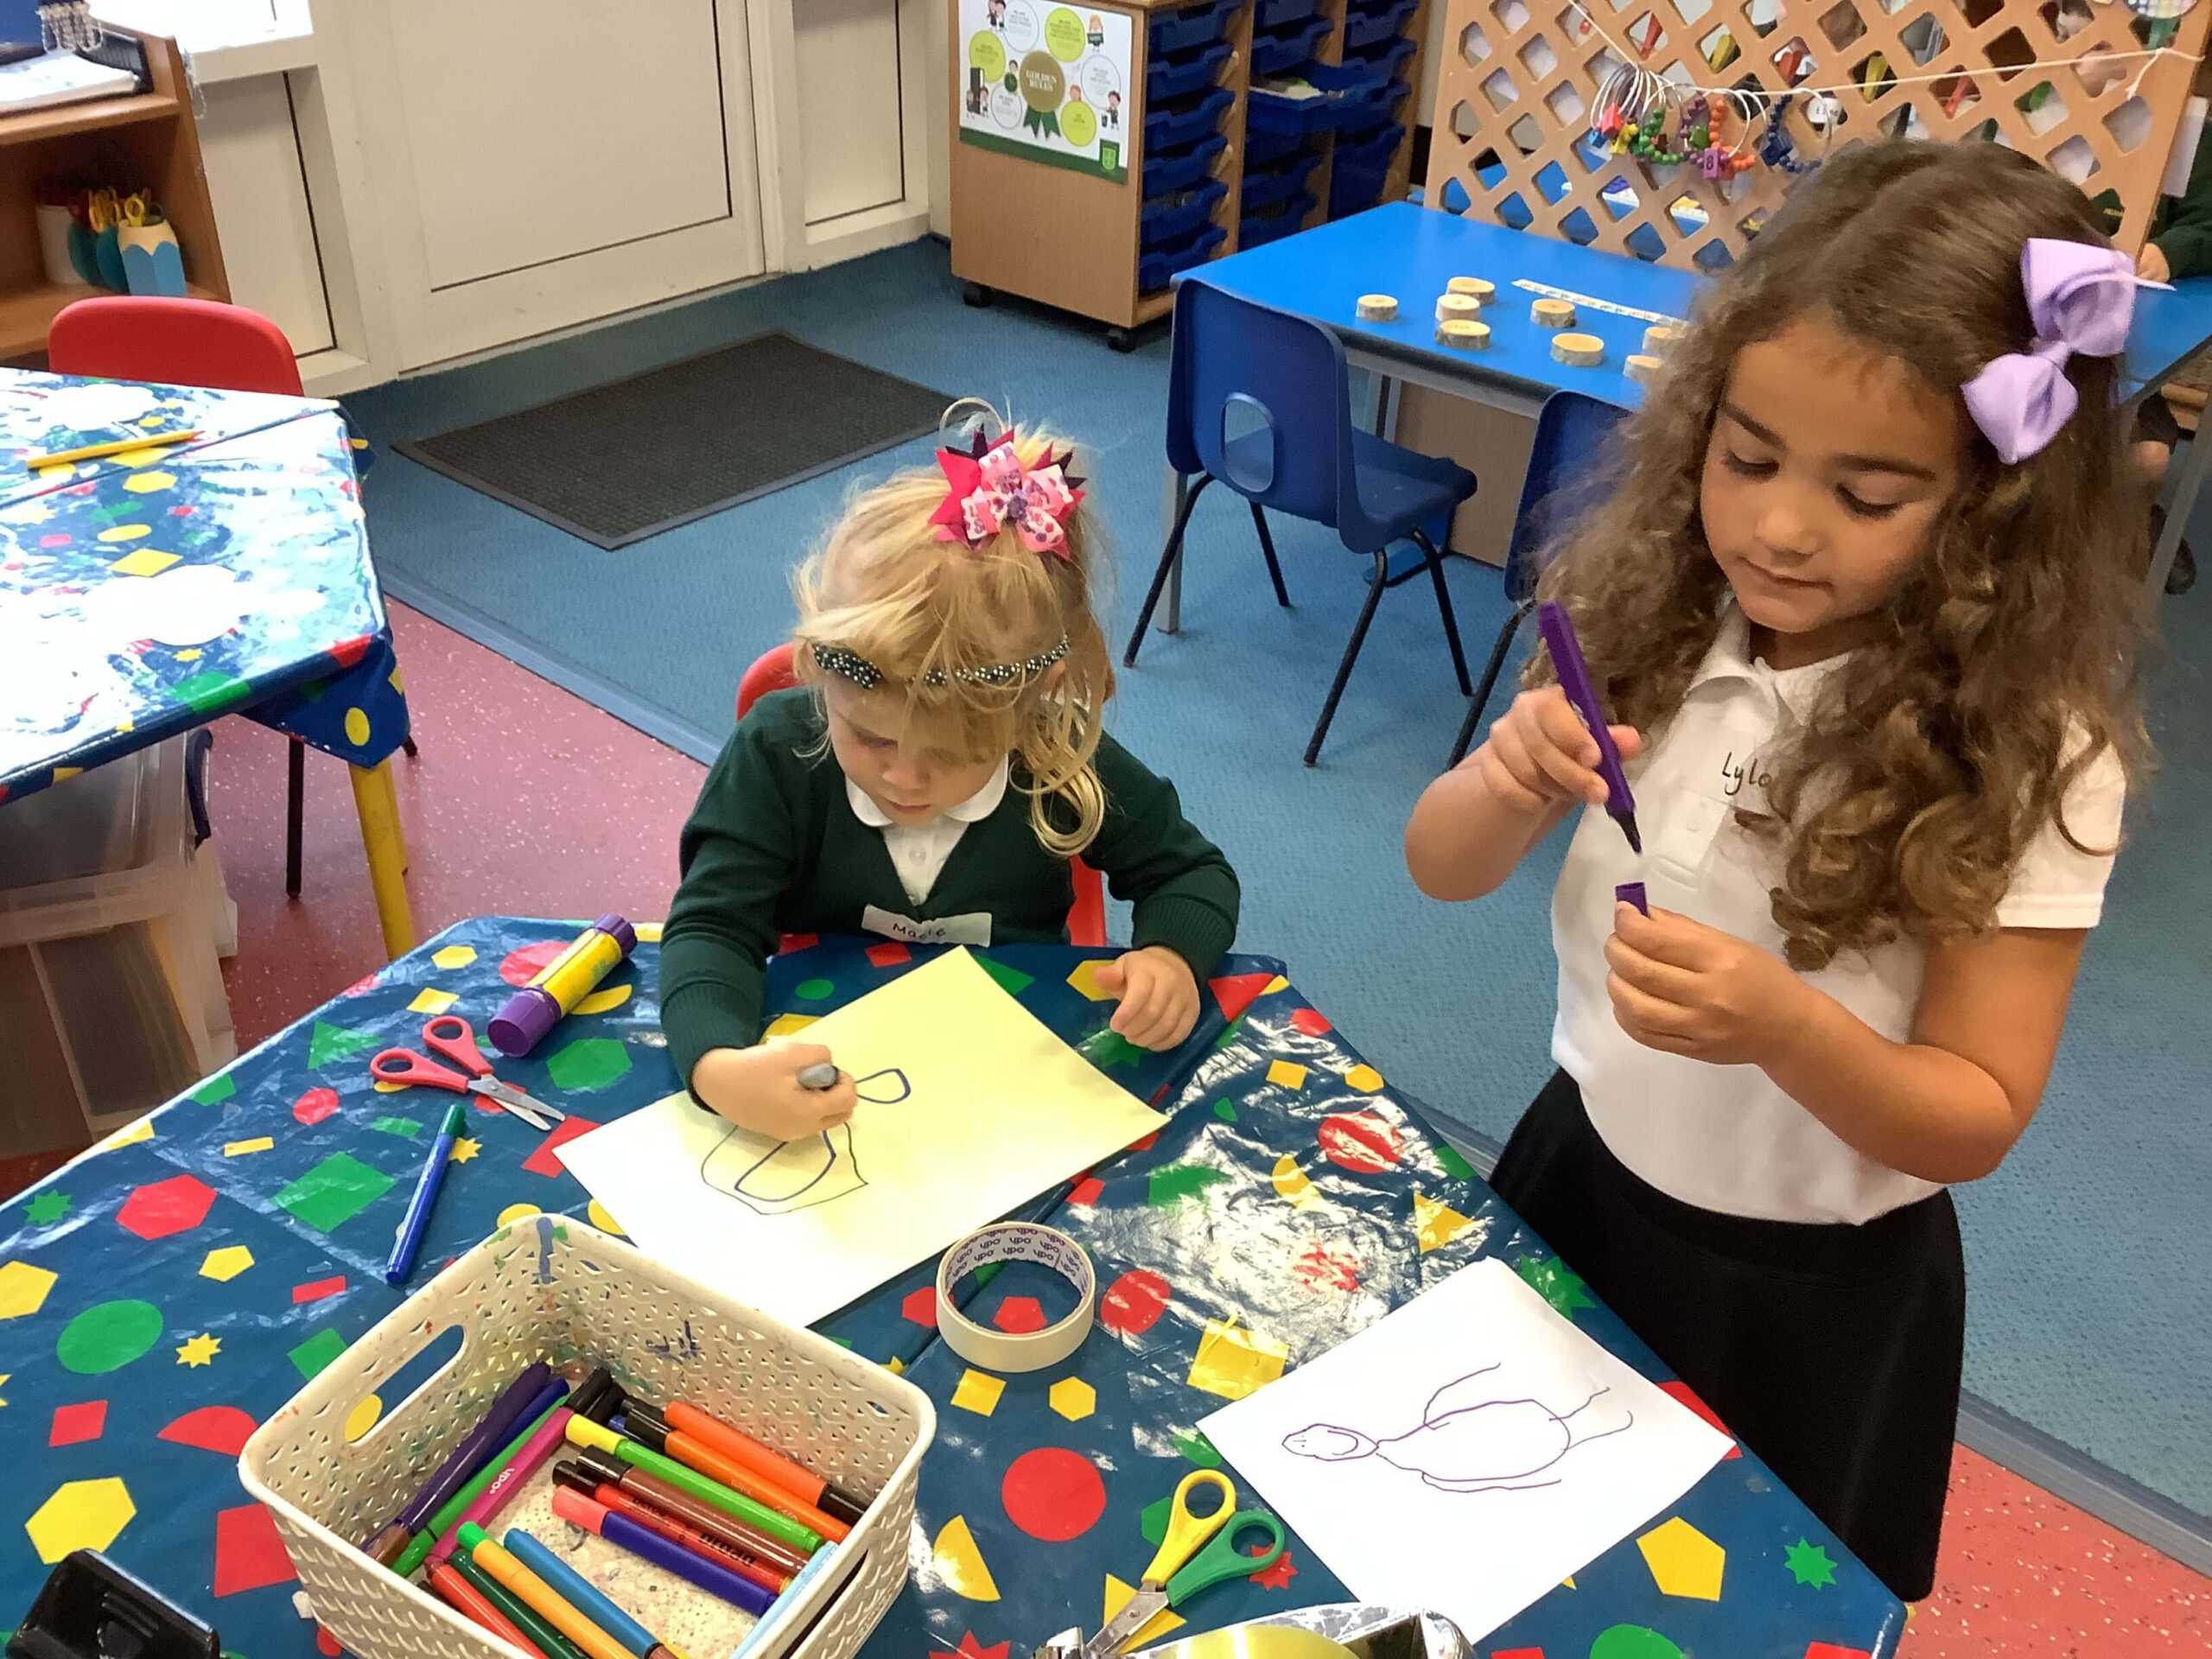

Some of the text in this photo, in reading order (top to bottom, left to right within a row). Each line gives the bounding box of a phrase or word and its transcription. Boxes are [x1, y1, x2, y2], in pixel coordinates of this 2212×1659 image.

[1026, 69, 1057, 84] GOLDEN
[1029, 79, 1053, 92] RULES
[1706, 155, 1714, 171] 8
[980, 1238, 1001, 1249] ypo
[1039, 1240, 1060, 1253] ypo
[974, 1249, 995, 1262] ypo
[1002, 1247, 1025, 1255] ypo
[1033, 1249, 1053, 1261] ypo
